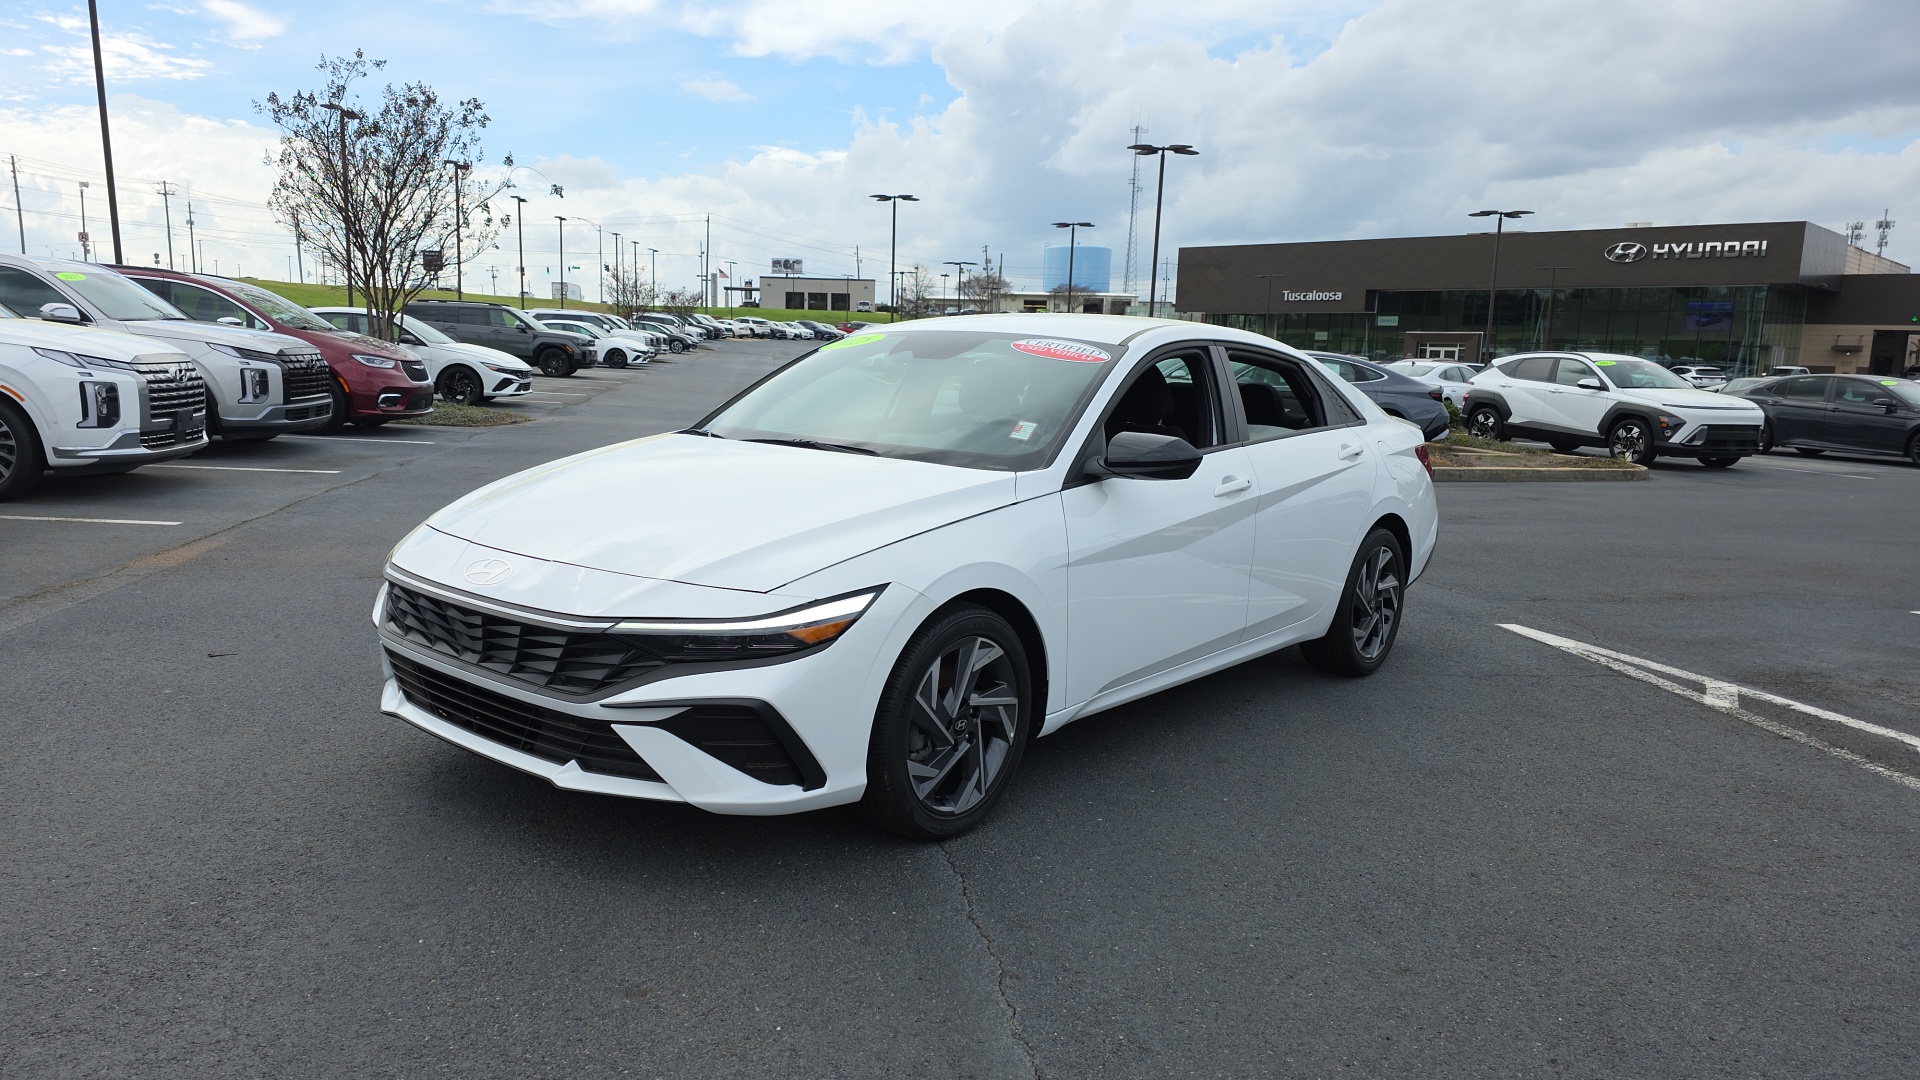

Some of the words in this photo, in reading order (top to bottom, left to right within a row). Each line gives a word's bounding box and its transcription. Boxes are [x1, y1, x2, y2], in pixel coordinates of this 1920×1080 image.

[1652, 240, 1768, 259] HYUNDAI
[1282, 290, 1342, 301] Tuscaloosa
[1019, 344, 1048, 352] USED
[1050, 349, 1096, 361] VEHICLE
[1026, 339, 1103, 356] CERTIFIED
